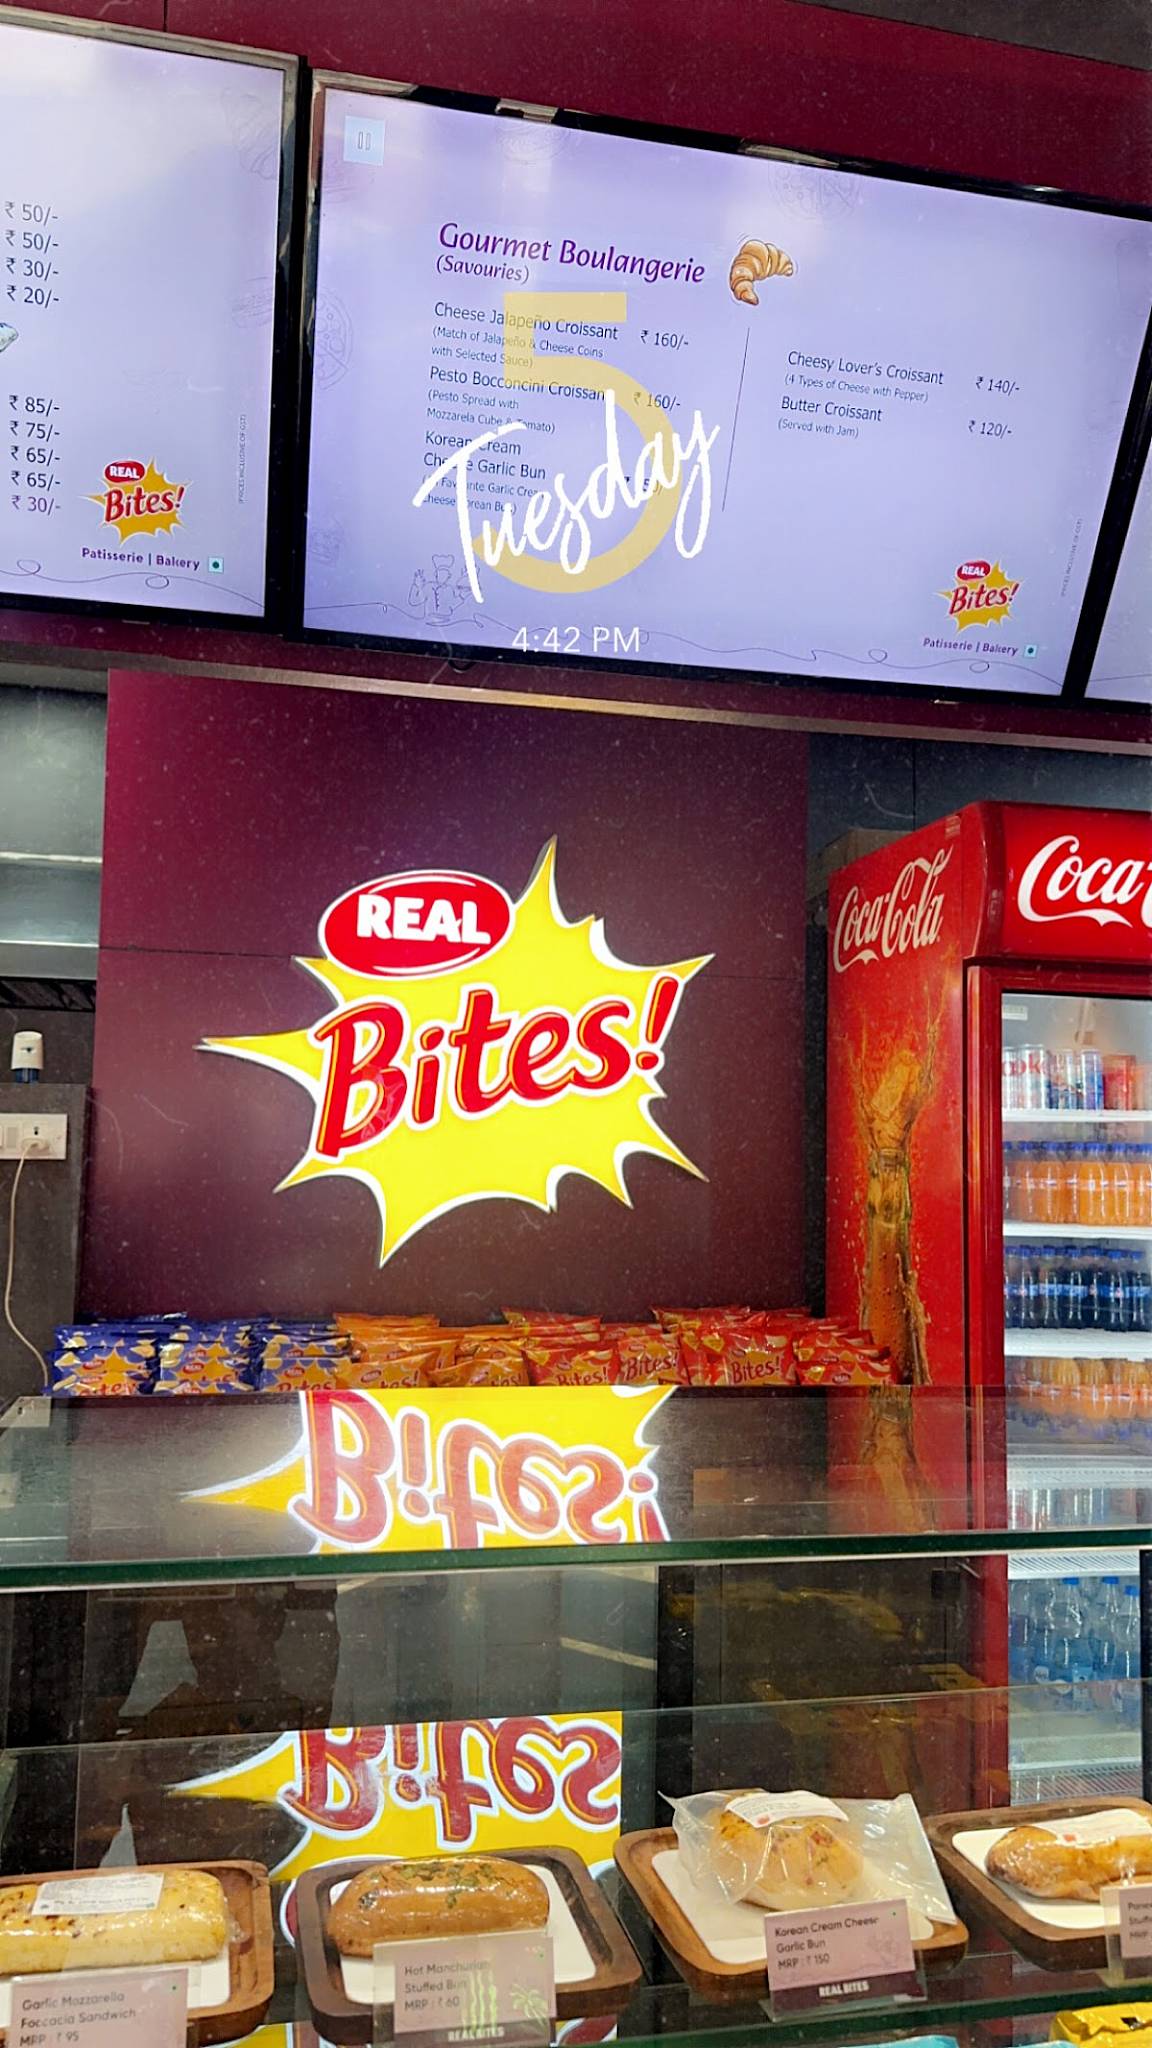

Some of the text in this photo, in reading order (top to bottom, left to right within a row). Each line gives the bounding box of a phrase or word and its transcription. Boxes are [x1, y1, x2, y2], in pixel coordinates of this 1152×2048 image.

[22, 203, 58, 226] 50/-
[5, 229, 59, 254] ₹ 50/-
[439, 222, 706, 283] Gourmet Boulangerie
[6, 256, 59, 282] ₹ 30/-
[436, 254, 530, 285] (Savouries)
[7, 284, 60, 309] ₹ 20/-
[434, 301, 619, 340] Cheese Jalapeño Croissant
[433, 327, 467, 340] (Match
[470, 332, 480, 341] of
[539, 340, 575, 355] Cheese
[577, 344, 603, 358] Coins
[640, 330, 689, 350] ₹ 160/-
[431, 346, 533, 368] with Selected Sauce)
[788, 350, 833, 372] Cheesy
[886, 364, 944, 385] Croissant
[430, 366, 605, 401] Pesto Bocconcini Croissan
[873, 386, 892, 397] with
[975, 376, 1020, 396] ₹ 140/-
[9, 395, 60, 417] ₹ 85/-
[428, 389, 519, 409] (Pesto Spread with
[647, 393, 681, 410] 160/-
[781, 396, 882, 422] Butter Croissant
[10, 420, 60, 442] ₹ 75/-
[426, 407, 475, 423] Mozzarela
[478, 414, 503, 426] Cube
[517, 418, 555, 434] omato)
[815, 423, 834, 435] with
[836, 424, 859, 438] Jam)
[968, 420, 1012, 439] ₹ 120/-
[10, 445, 61, 467] ₹ 65/-
[424, 452, 546, 479] Chee Garlic Bun
[11, 470, 61, 491] ₹ 65/-
[110, 466, 140, 479] REAL
[488, 482, 514, 496] Garlic
[27, 496, 61, 516] 30/-
[105, 486, 185, 522] Bites!
[424, 494, 456, 506] heese
[82, 548, 200, 571] Patisserie Bakery
[961, 565, 986, 577] REAL
[949, 583, 1019, 615] Bites!
[923, 638, 1018, 656] Patisserie Bakery
[357, 893, 491, 945] REAL
[314, 976, 679, 1157] Bites!
[731, 1355, 780, 1384] Bites!
[775, 1925, 809, 1938] Korean
[810, 1921, 842, 1933] Cream
[776, 1939, 826, 1954] Garlic Bun
[404, 1965, 424, 1977] Hot
[777, 1958, 799, 1970] MRP
[814, 1953, 830, 1965] 150
[404, 1981, 444, 1994] Stuffed
[818, 1980, 870, 1998] REAL BITES
[22, 1998, 57, 2011] Garlic
[404, 1999, 429, 2012] MRP
[446, 1996, 460, 2008] 60
[79, 2008, 136, 2023] Sandwich
[66, 2031, 80, 2042] 95
